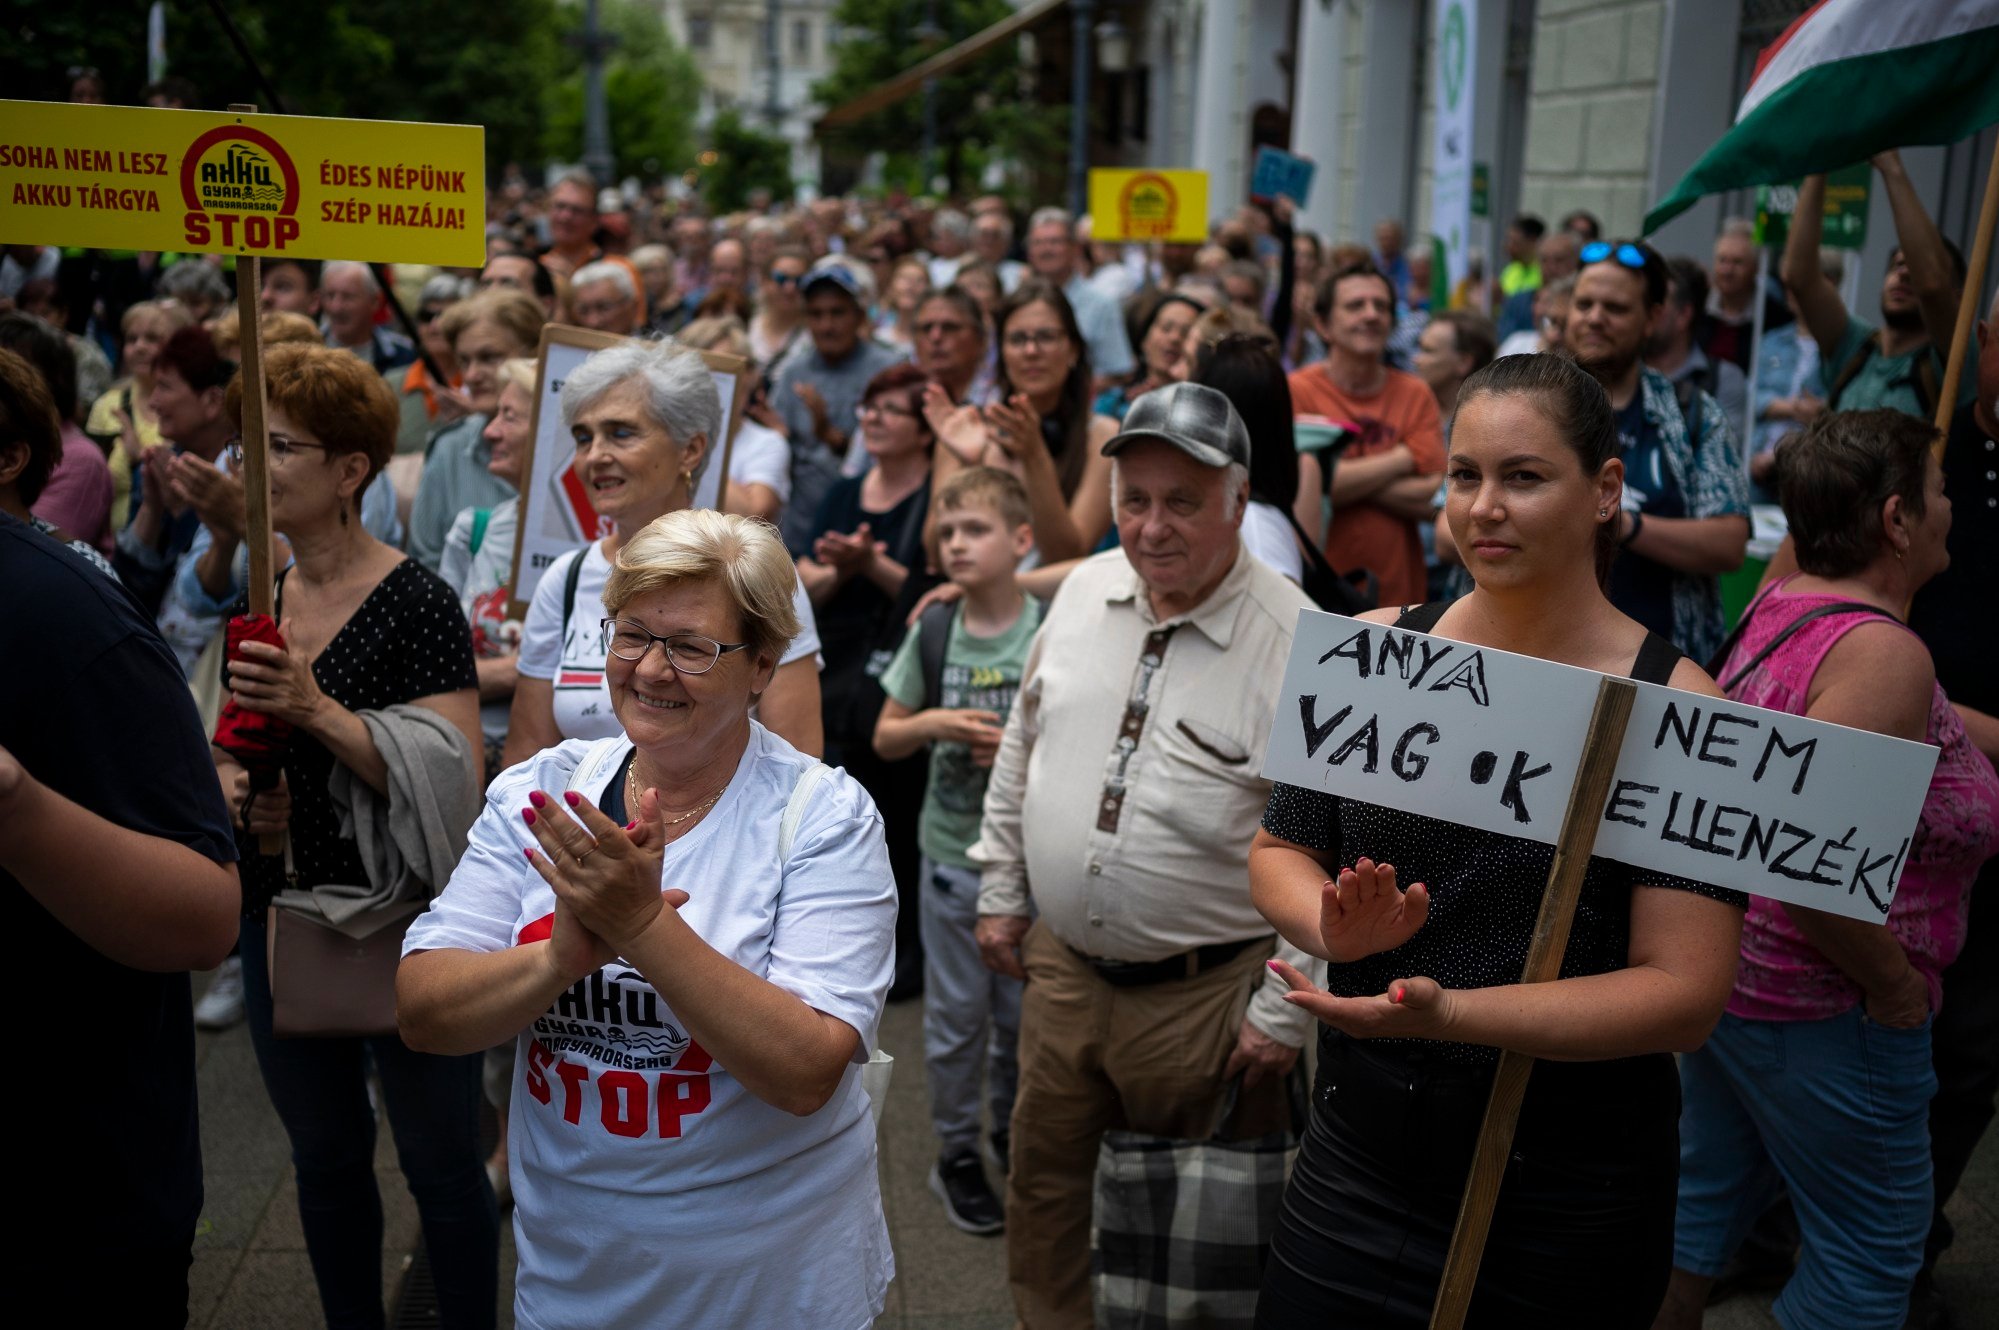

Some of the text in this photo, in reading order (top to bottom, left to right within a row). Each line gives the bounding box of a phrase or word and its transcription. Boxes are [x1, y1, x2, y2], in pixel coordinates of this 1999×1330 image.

[0, 144, 168, 176] SOHA NEM LESZ
[201, 149, 272, 186] AKKU
[320, 159, 466, 193] ÉDES NÉPÜNK
[12, 183, 160, 212] AKKU TÁRGYA
[202, 184, 241, 198] GYÁR
[184, 212, 300, 250] STOP
[320, 198, 465, 230] SZÉP HAZÁJA!
[1317, 628, 1490, 707] ANYA
[1654, 702, 1818, 796] NEM
[546, 968, 664, 1029] KKU
[534, 1016, 607, 1040] GYÁR
[526, 1038, 712, 1140] STOP
